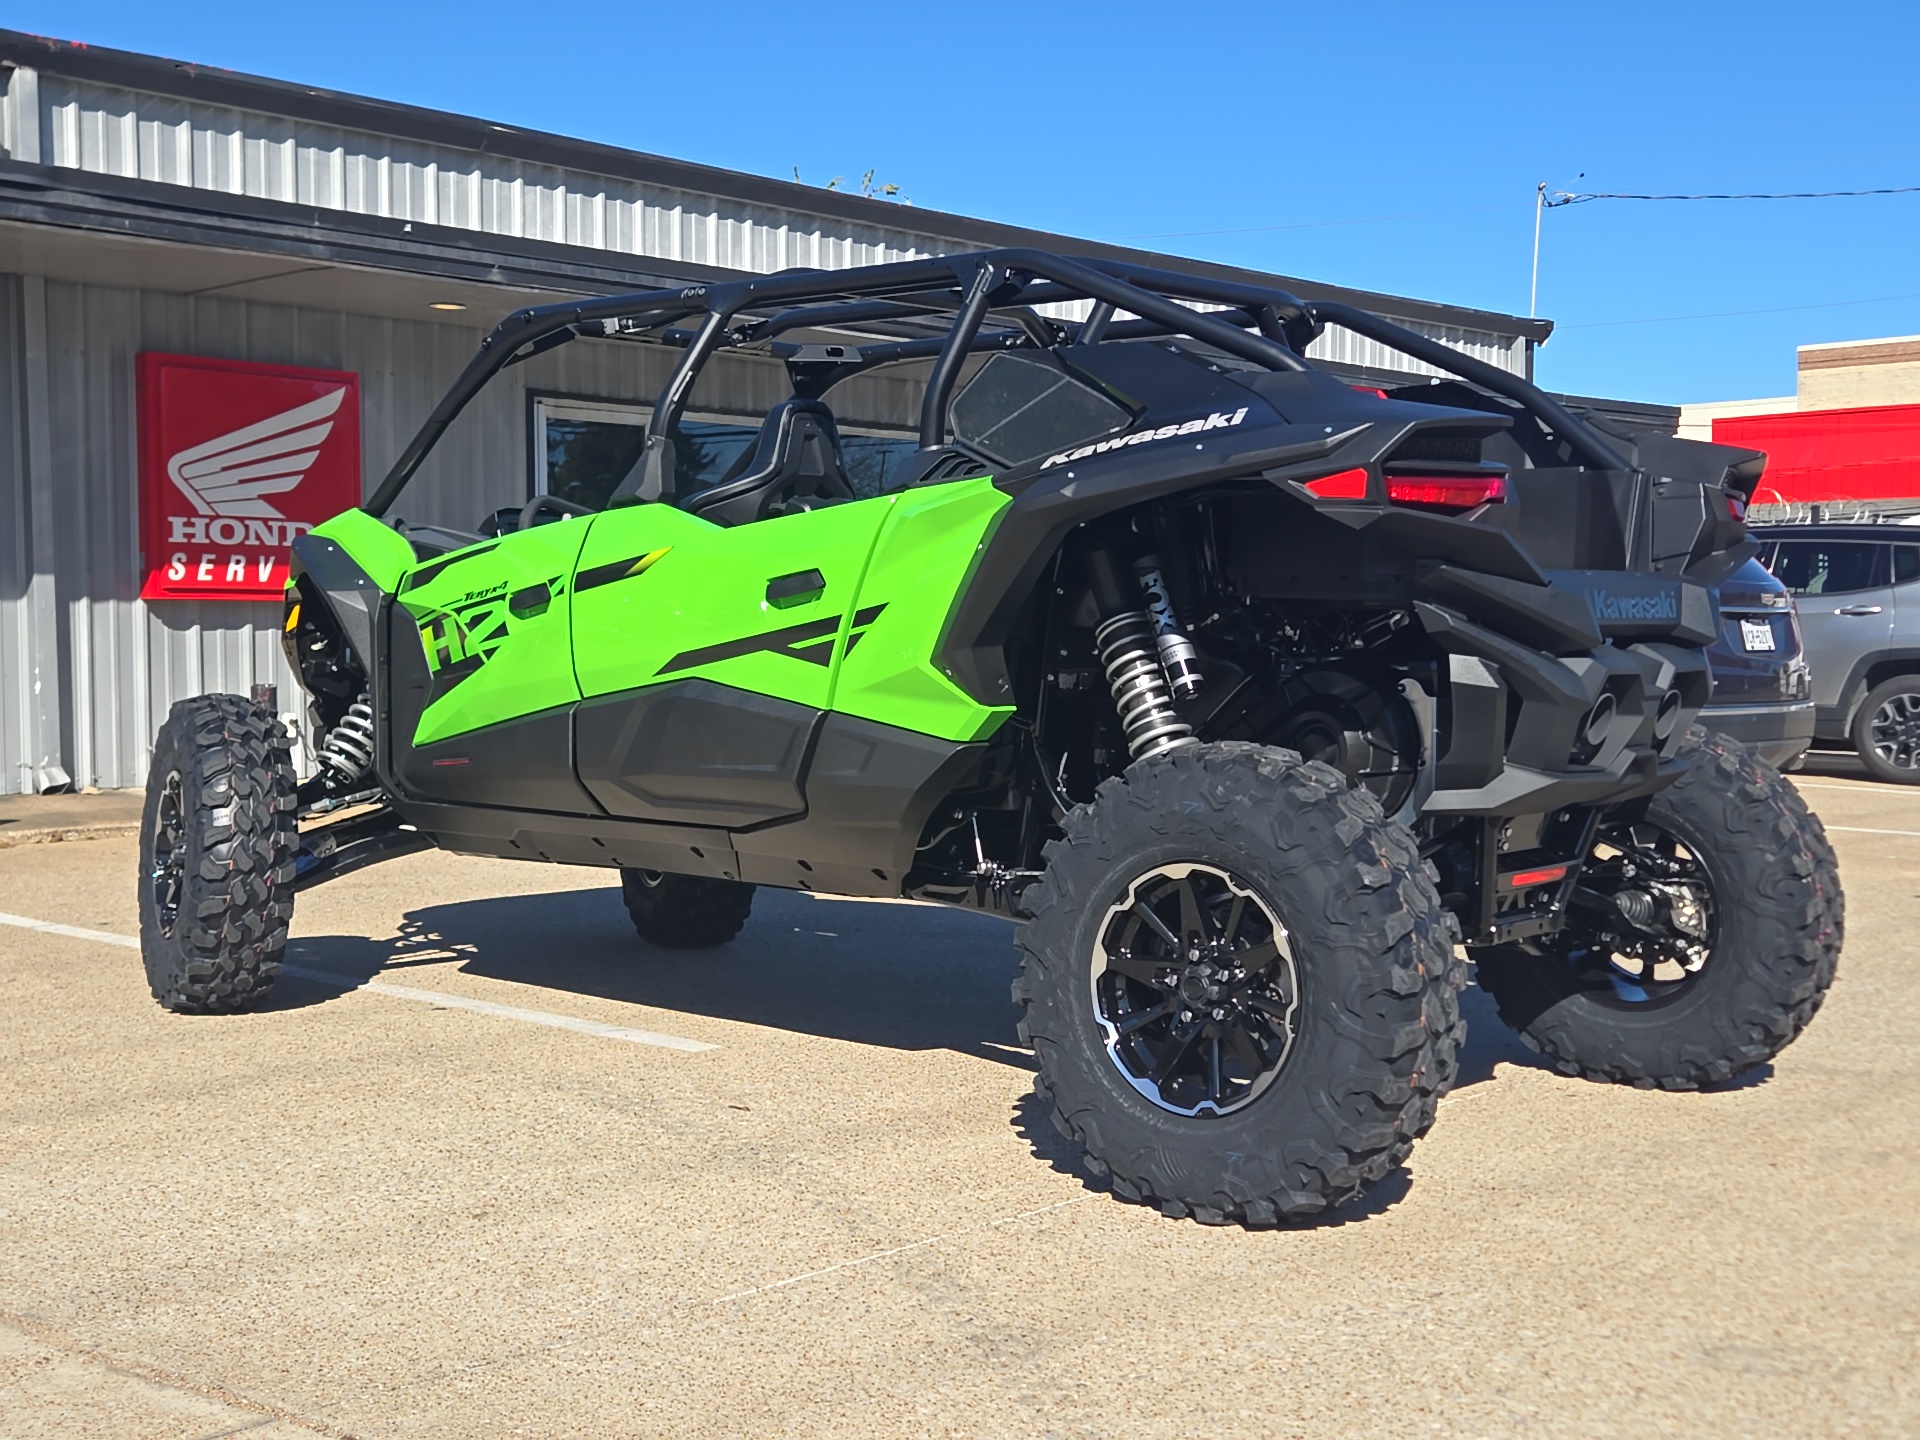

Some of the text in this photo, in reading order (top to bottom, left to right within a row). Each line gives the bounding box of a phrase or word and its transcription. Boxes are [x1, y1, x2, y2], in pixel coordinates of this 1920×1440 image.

[1040, 407, 1249, 470] Kawasaki
[168, 516, 314, 546] HOND
[168, 552, 276, 582] SERV
[1140, 569, 1178, 635] FOX
[1593, 589, 1677, 619] Kawasaki
[421, 600, 509, 673] H2
